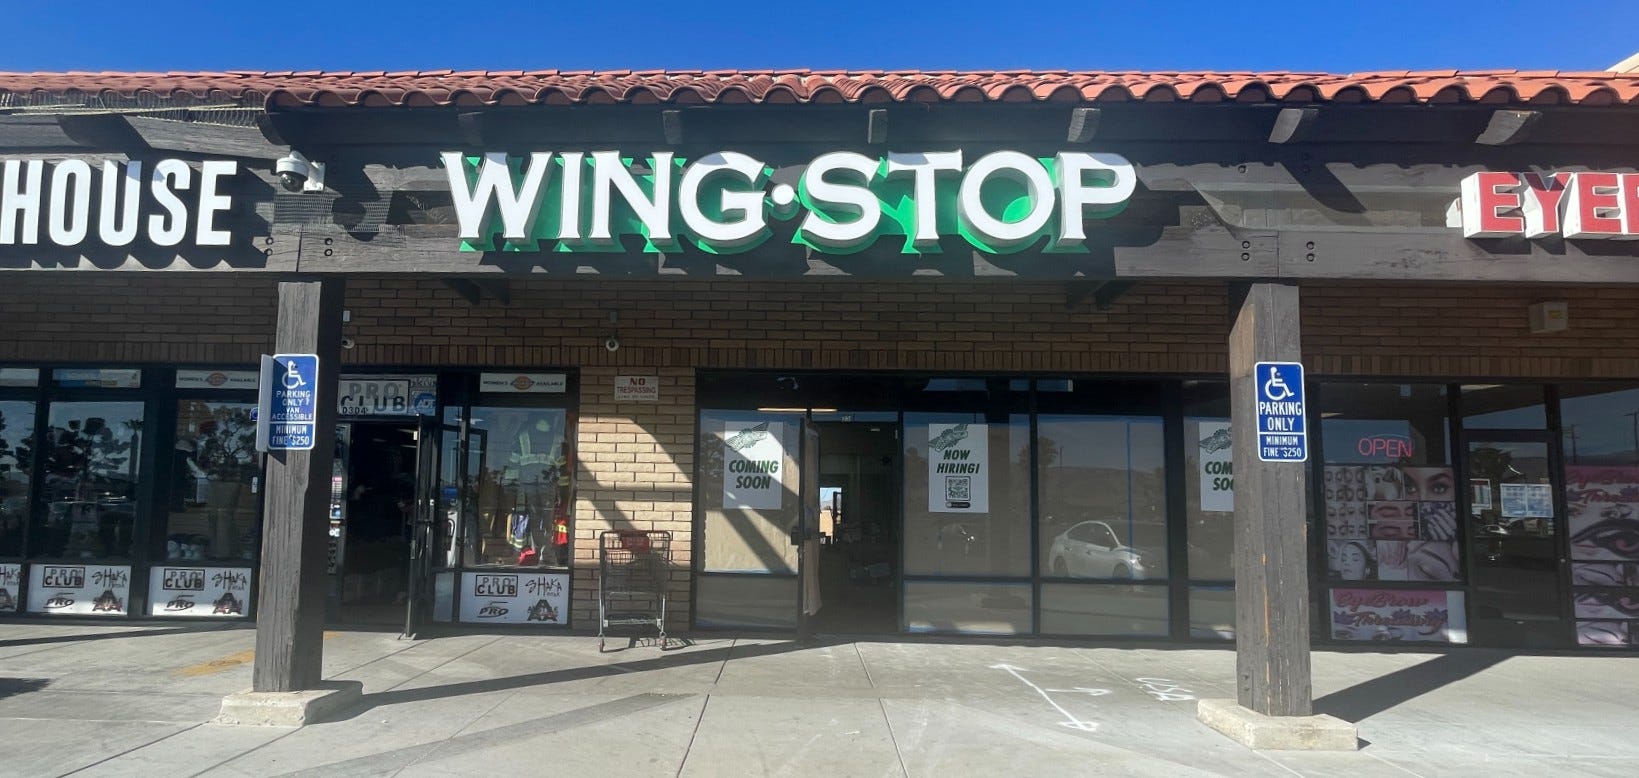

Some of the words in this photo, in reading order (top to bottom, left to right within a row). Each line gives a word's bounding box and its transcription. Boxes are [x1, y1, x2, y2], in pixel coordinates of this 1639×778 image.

[0, 158, 238, 246] HOUSE
[630, 377, 646, 386] NO
[276, 390, 311, 398] PARKING
[349, 382, 399, 399] PRO
[616, 386, 656, 394] TRESPASSING
[282, 398, 304, 406] ONLY
[1259, 401, 1302, 416] PARKING
[271, 413, 313, 421] ACCESSIBLE
[1267, 416, 1295, 431] ONLY
[275, 425, 307, 435] MINIMUM
[272, 435, 288, 446] FINE
[290, 436, 310, 446] $250
[1266, 435, 1298, 446] MINIMUM
[1263, 447, 1279, 457] FINE
[1282, 447, 1302, 457] $250
[1358, 438, 1412, 457] OPEN
[943, 449, 971, 461] NOW
[728, 459, 779, 474] COMING
[1205, 461, 1233, 475] COM
[736, 475, 771, 490] SOON
[1212, 477, 1234, 491] SO
[51, 569, 80, 579] PRO
[169, 571, 201, 581] PRO
[44, 576, 83, 586] CLUB
[165, 578, 203, 589] CLUB
[482, 577, 515, 587] PRO
[477, 584, 516, 595] CLUB
